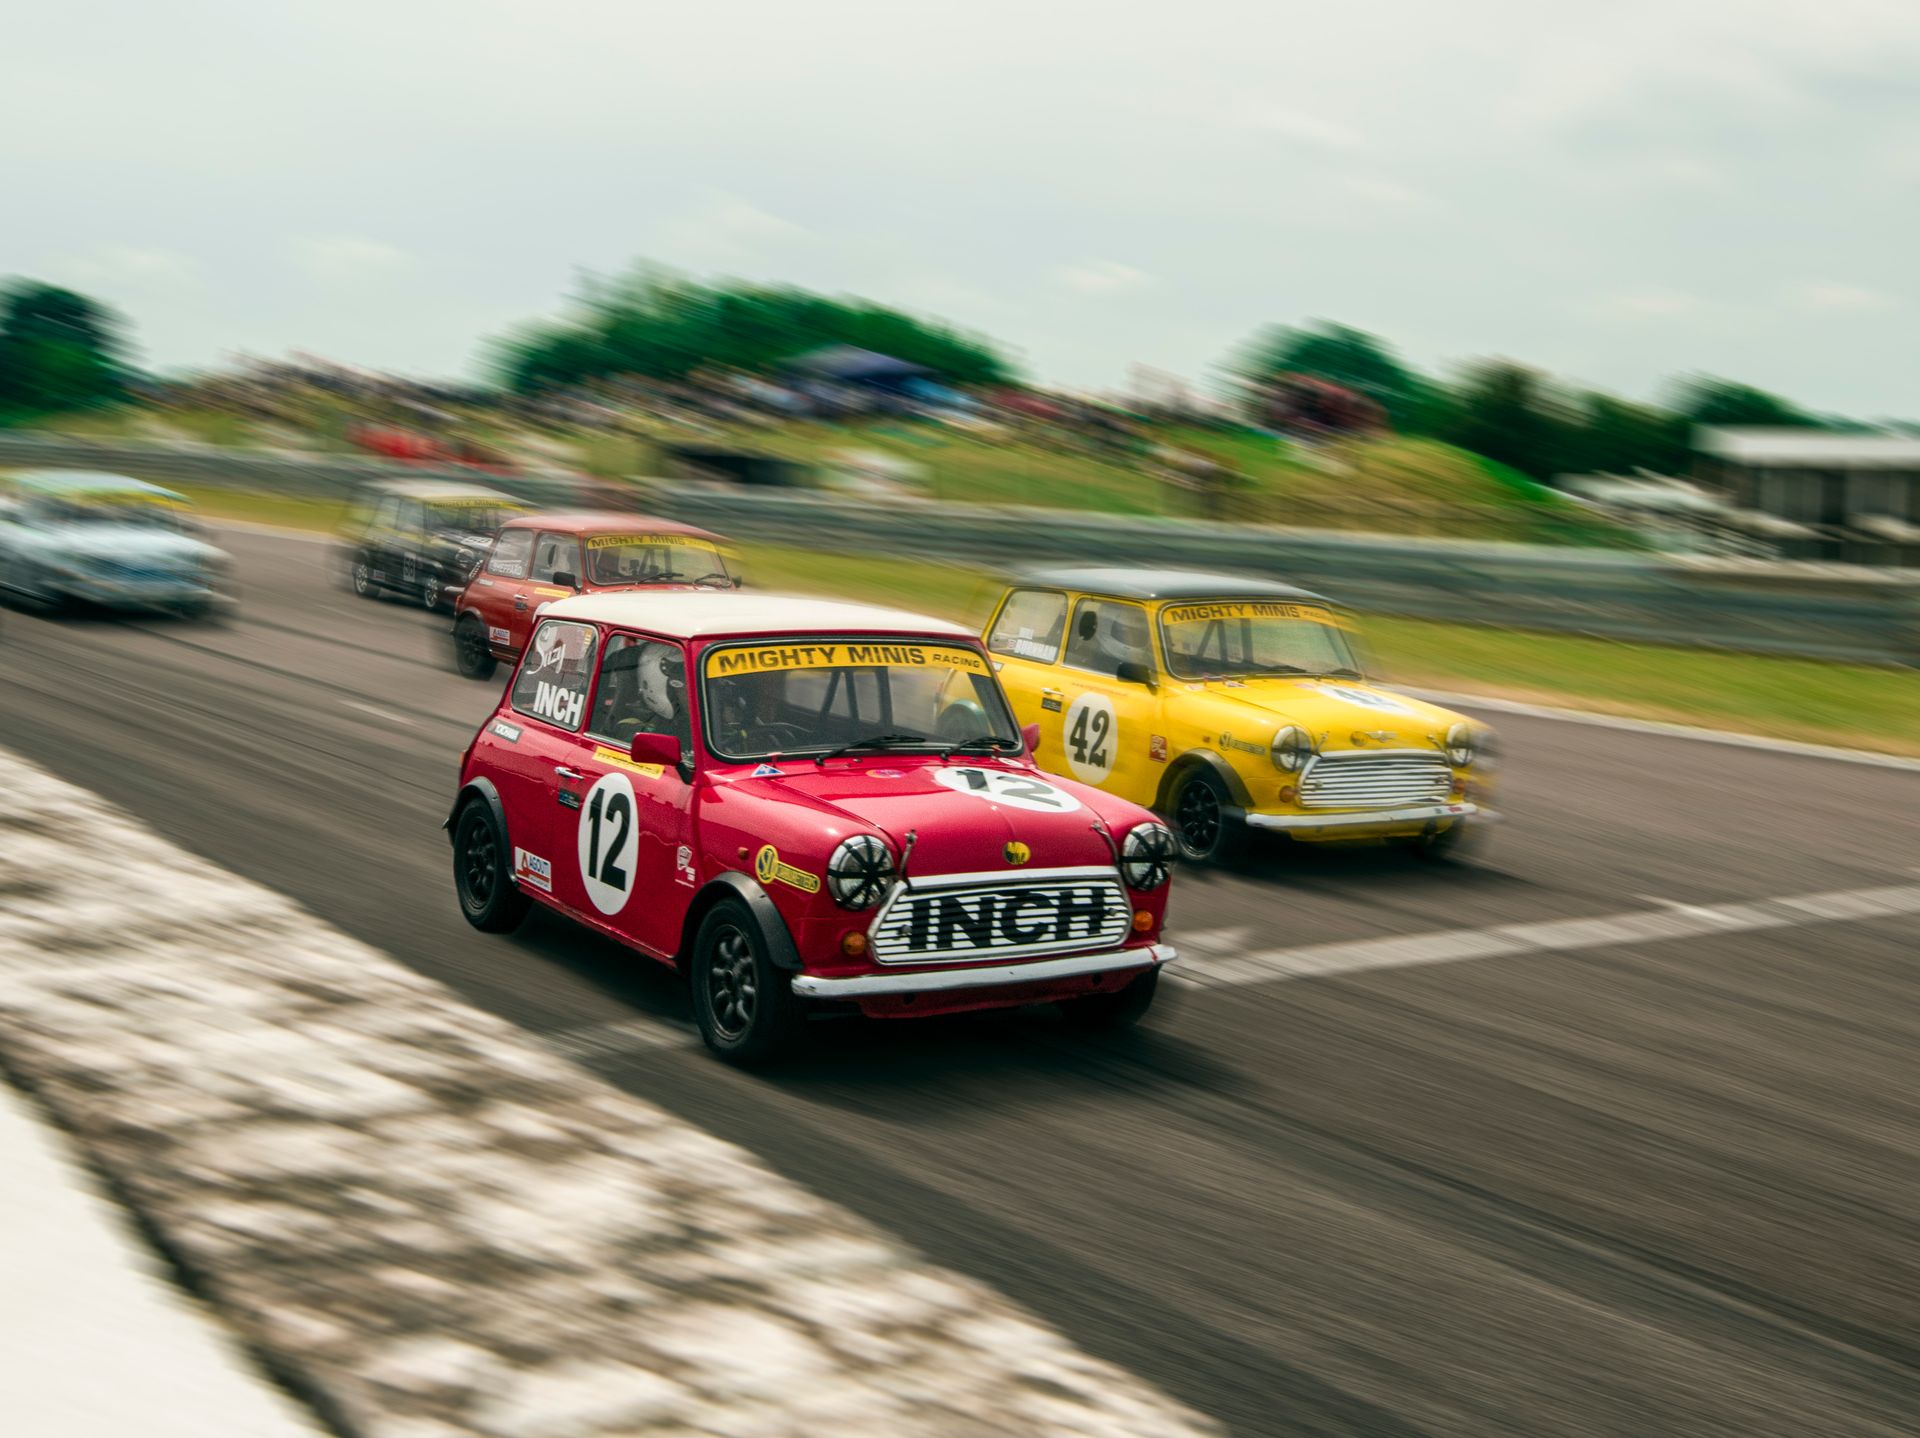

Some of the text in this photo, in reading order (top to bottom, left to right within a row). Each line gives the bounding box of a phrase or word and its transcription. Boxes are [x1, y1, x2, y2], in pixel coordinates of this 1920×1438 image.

[592, 536, 686, 548] MIGHTY MINIS
[1171, 605, 1246, 622] MIGHTY
[1250, 604, 1301, 618] MINIS
[526, 626, 566, 674] Suzy
[718, 646, 980, 673] MIGHTY MINIS RACING
[533, 681, 584, 726] INCH
[1069, 706, 1109, 768] 42
[955, 769, 1063, 808] 12
[588, 787, 630, 892] 12
[909, 888, 1104, 950] INCH
